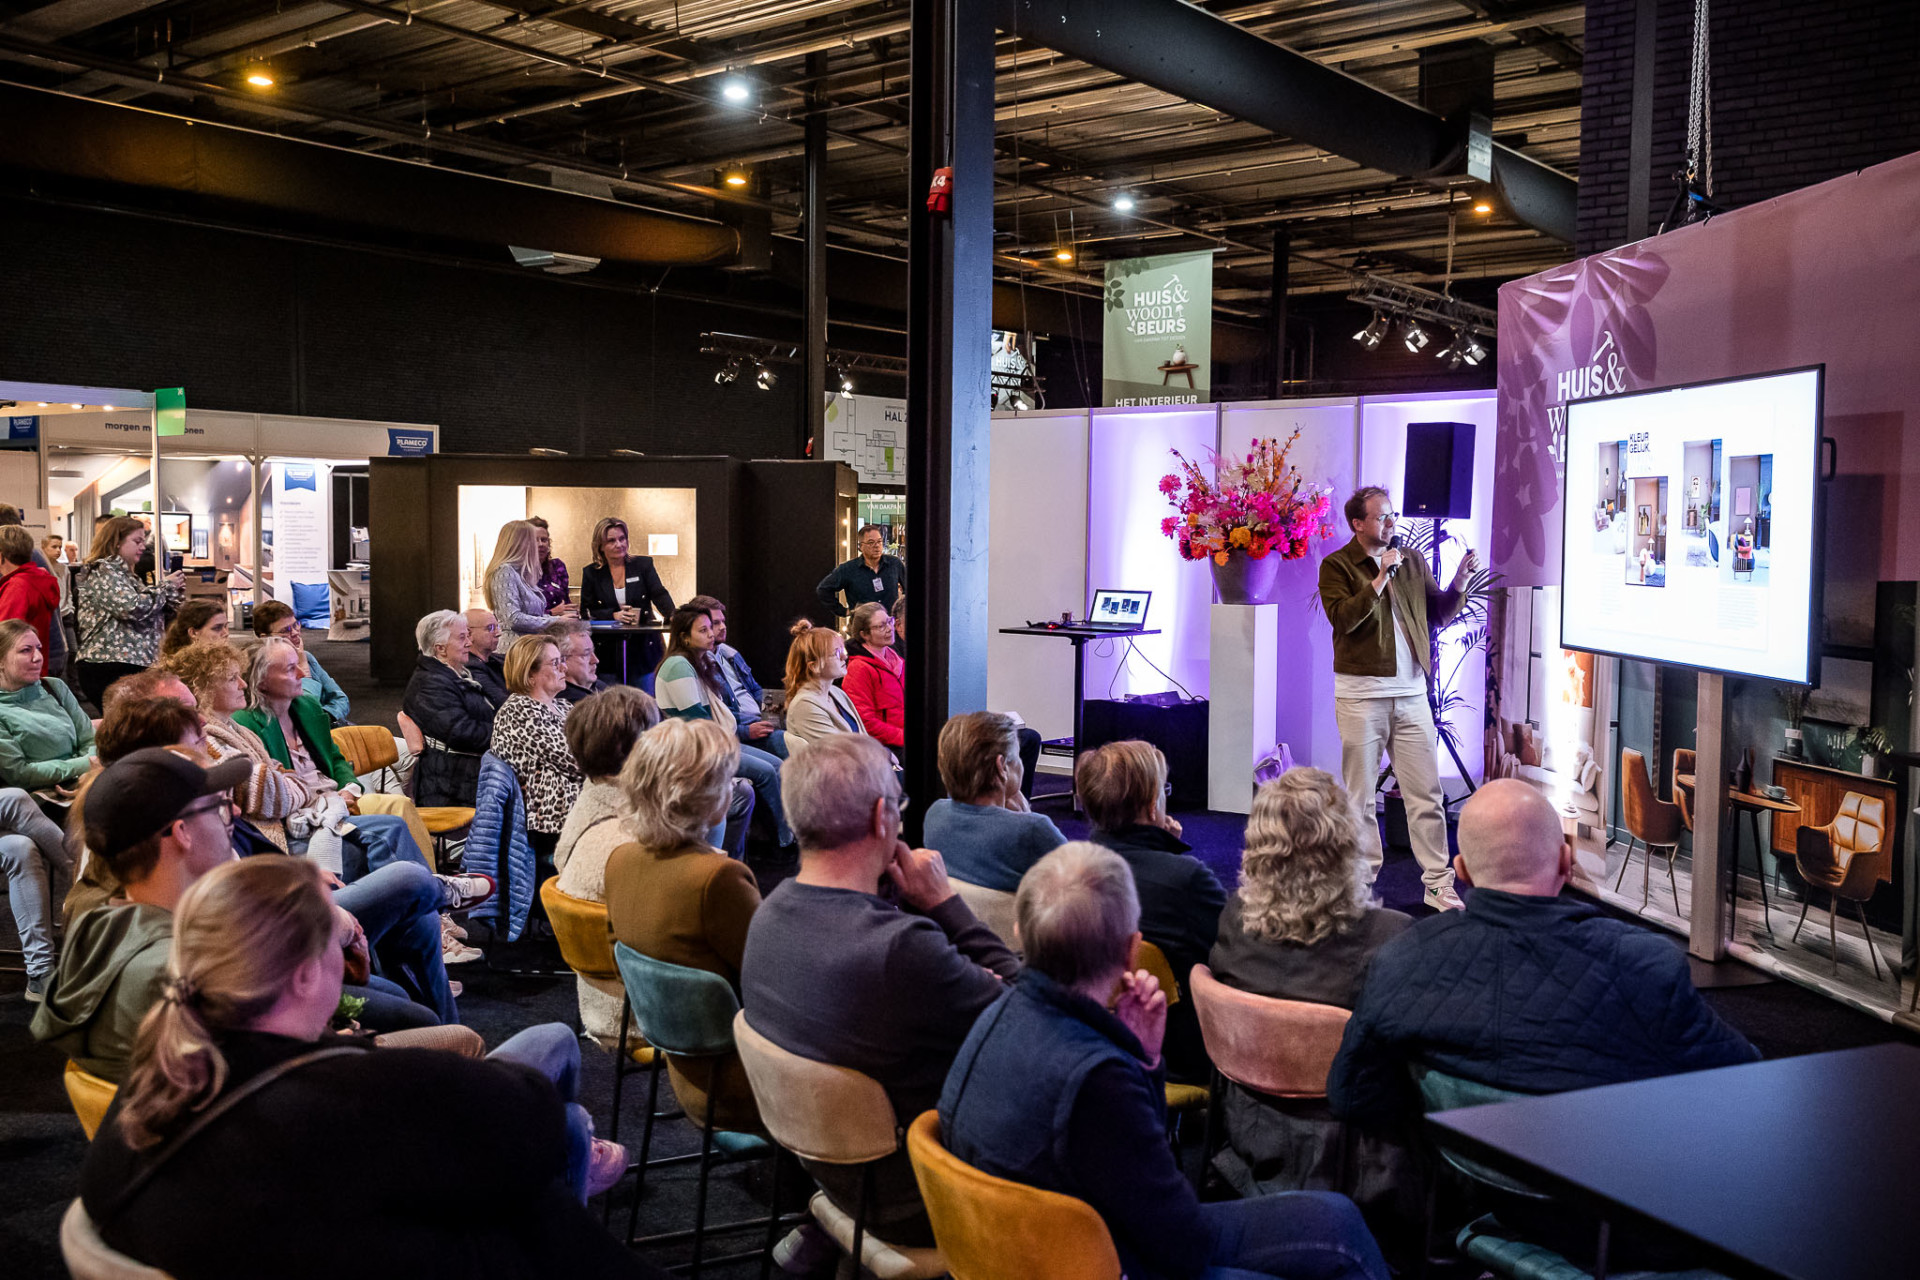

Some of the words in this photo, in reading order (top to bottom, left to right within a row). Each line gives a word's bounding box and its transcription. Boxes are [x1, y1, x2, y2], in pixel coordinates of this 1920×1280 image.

[1126, 306, 1172, 321] woon
[1137, 319, 1186, 335] BEURS
[1115, 398, 1136, 408] HET
[1139, 395, 1198, 407] INTERIEUR
[885, 410, 902, 422] HAL
[105, 422, 140, 432] morgen
[1630, 432, 1649, 443] KLEUR
